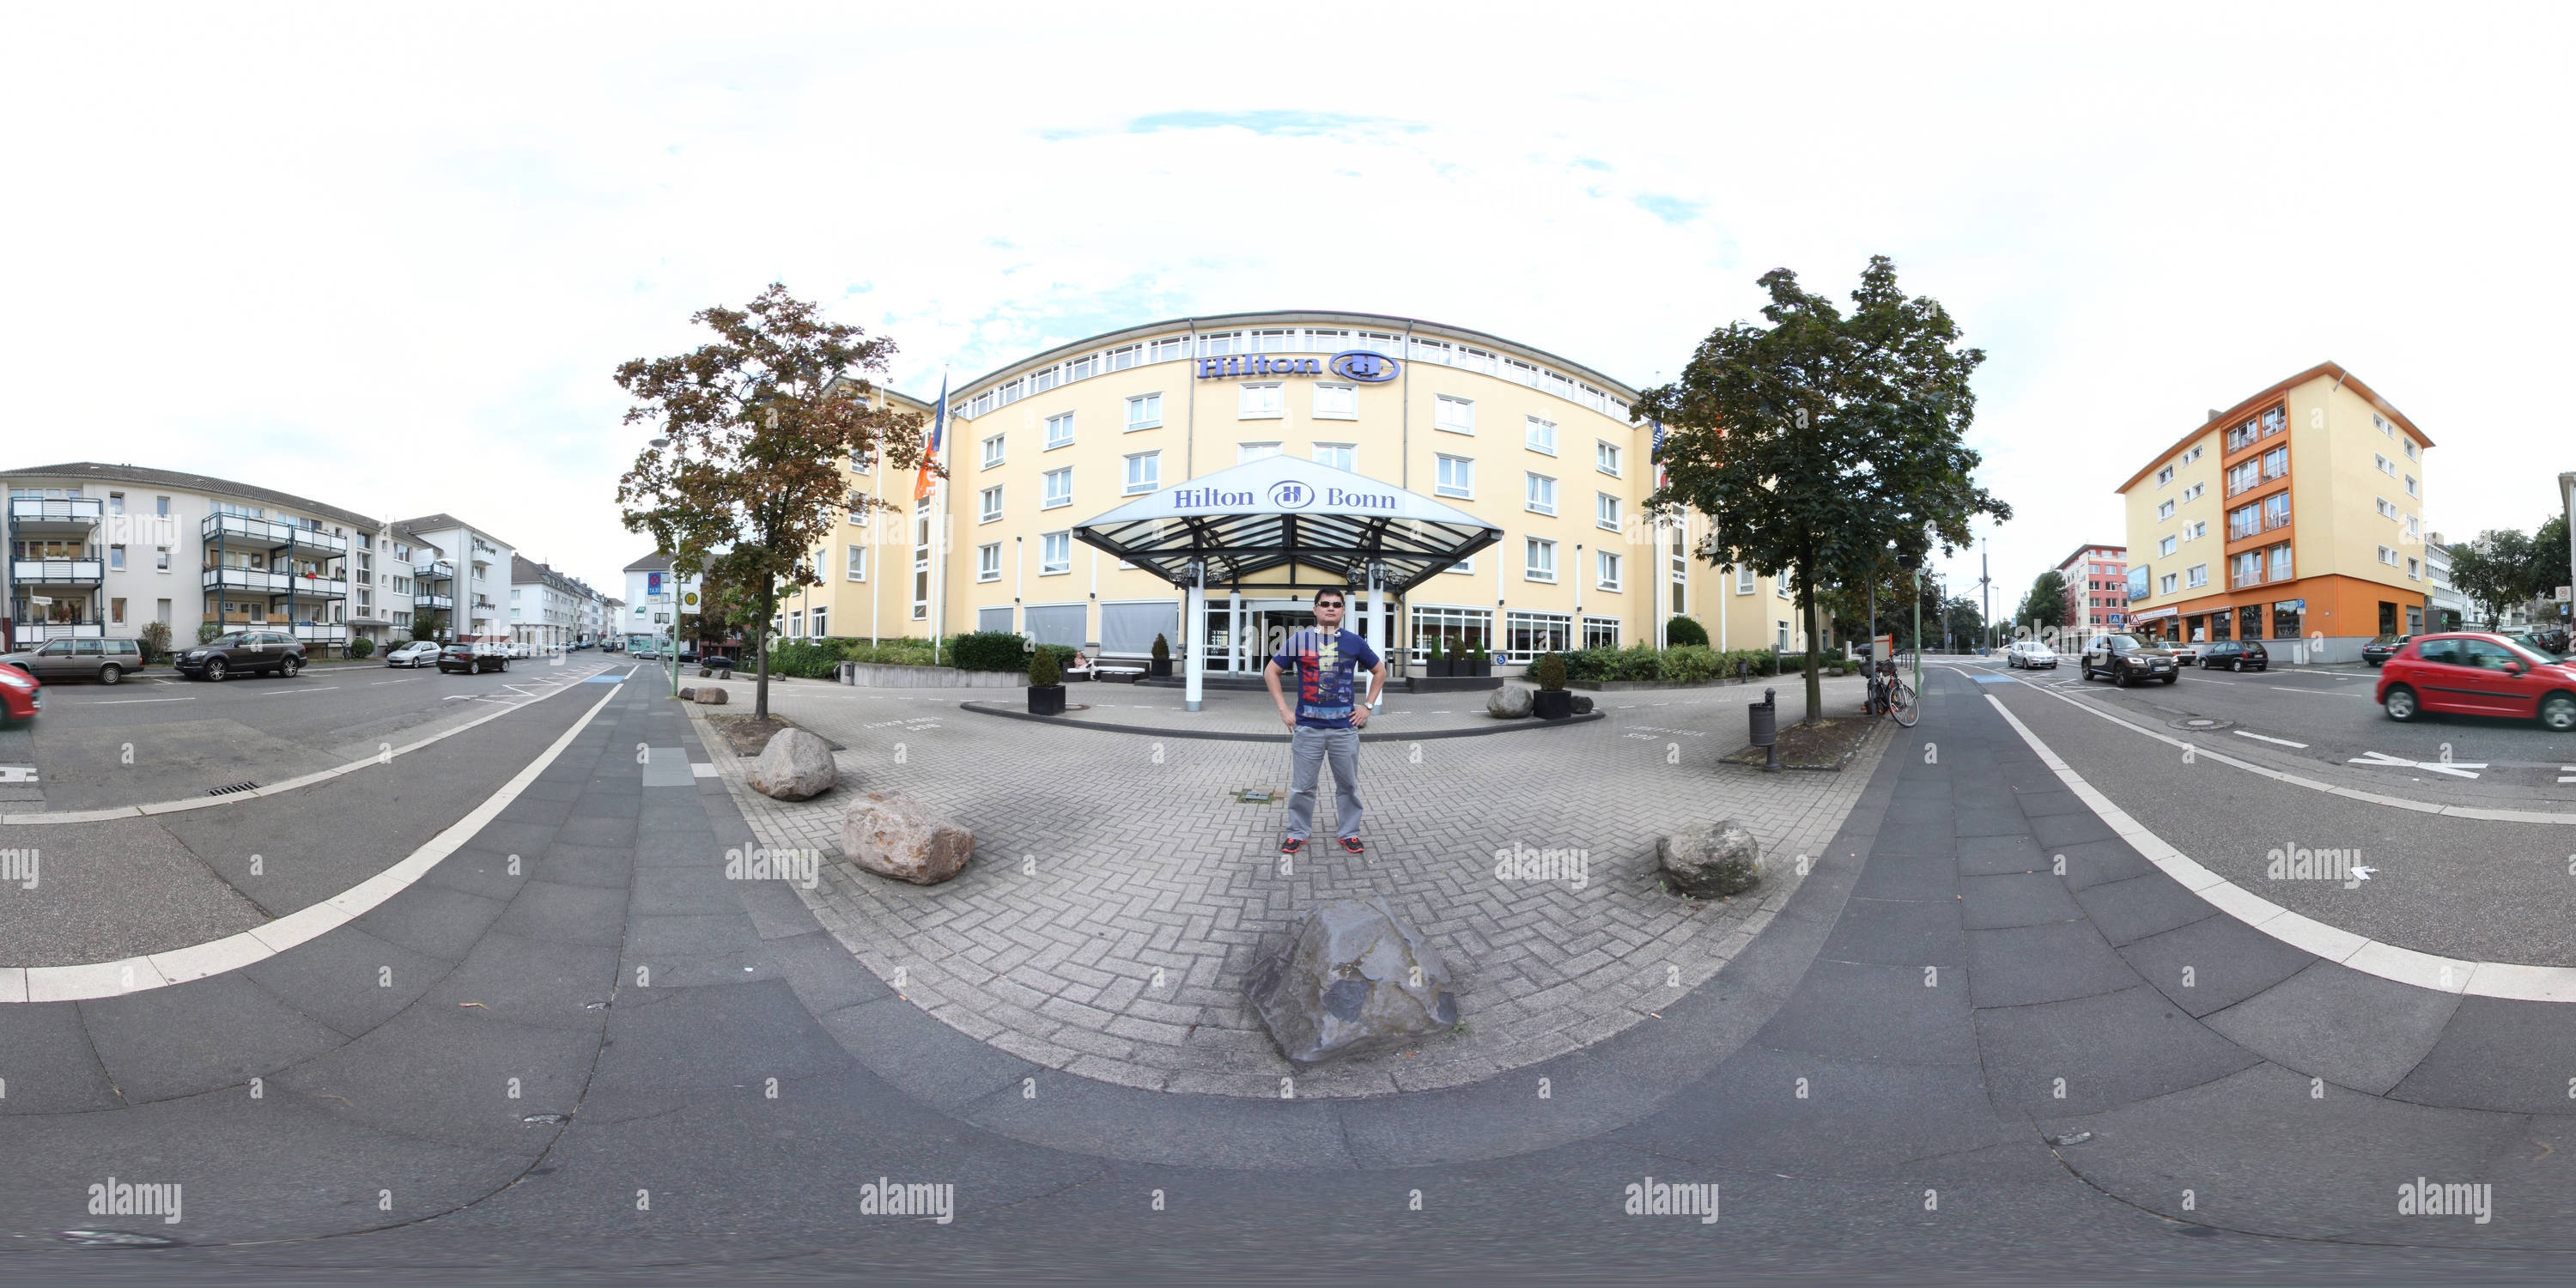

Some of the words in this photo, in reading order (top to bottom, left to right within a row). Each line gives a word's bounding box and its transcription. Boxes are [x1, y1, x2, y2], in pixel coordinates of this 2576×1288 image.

[1197, 353, 1323, 380] Hilton
[1174, 487, 1255, 508] Hilton
[1326, 488, 1397, 509] Bonn
[1299, 650, 1319, 702] NEW
